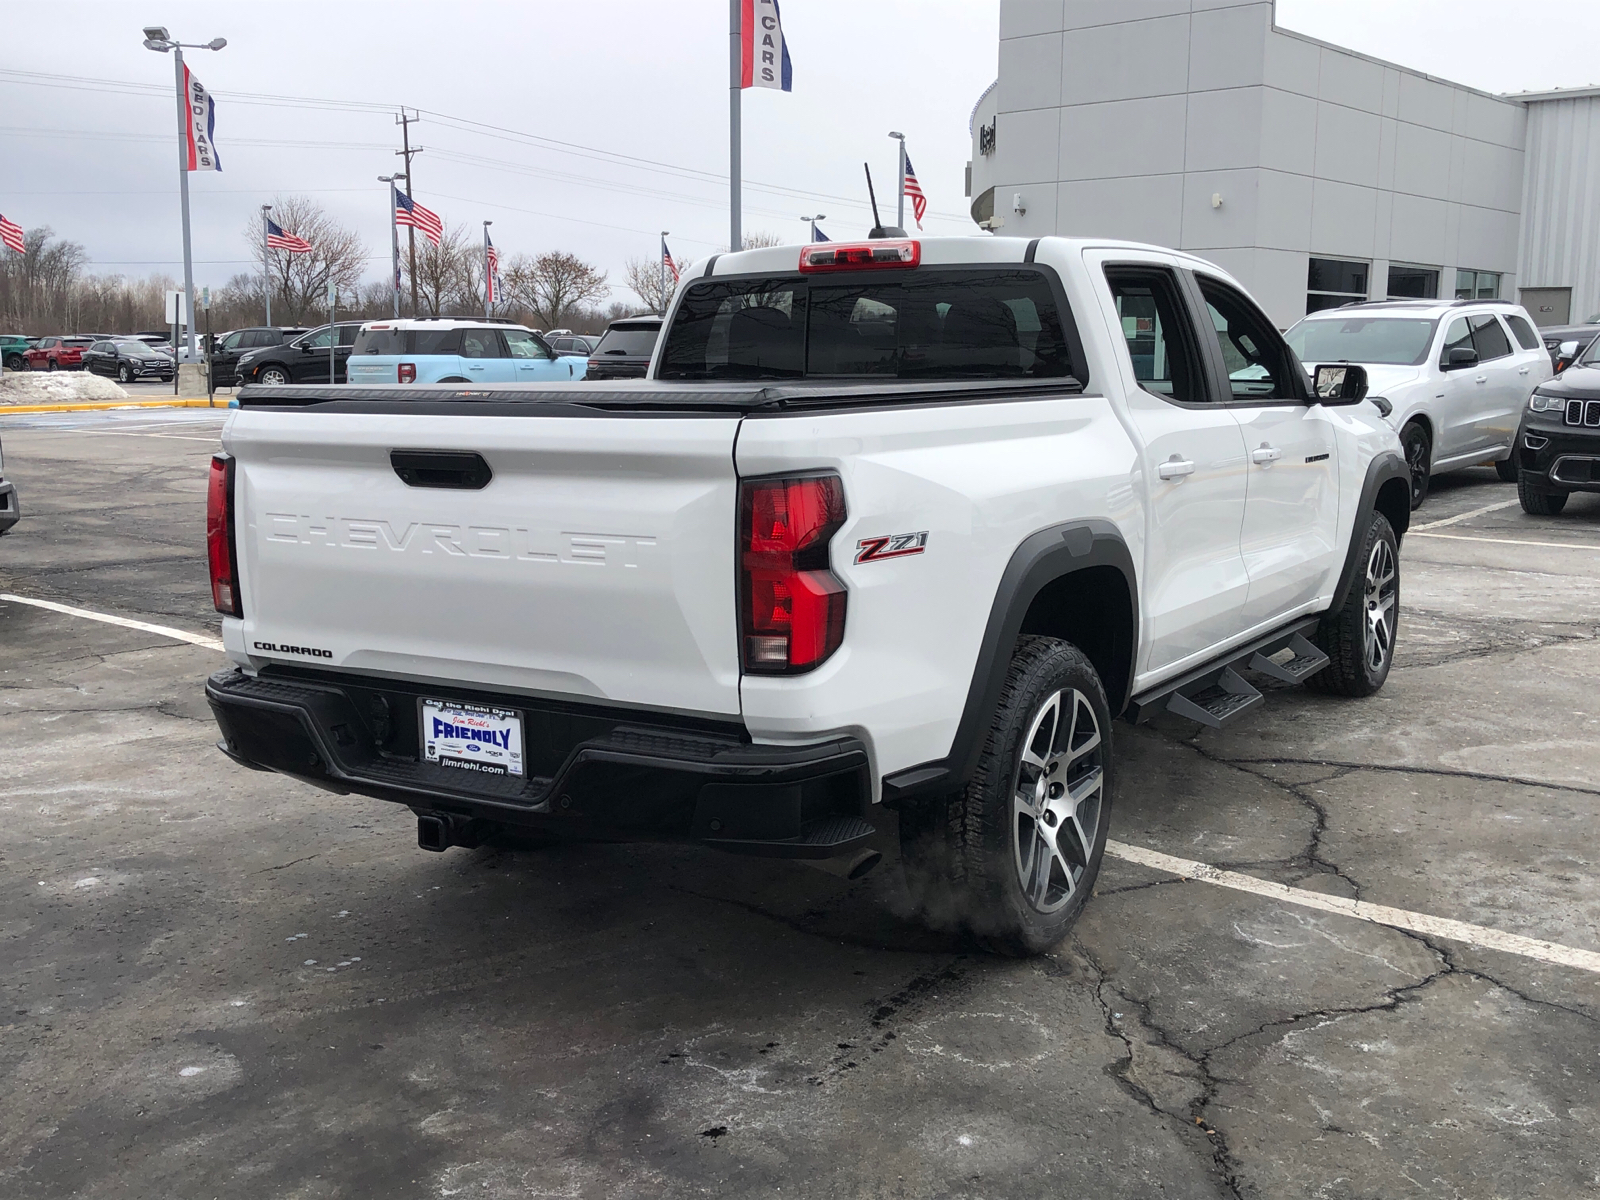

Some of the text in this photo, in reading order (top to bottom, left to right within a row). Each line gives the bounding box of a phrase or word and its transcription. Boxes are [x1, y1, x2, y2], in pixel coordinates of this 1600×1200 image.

[761, 16, 776, 82] CARS
[192, 82, 211, 166] SED CARS
[265, 512, 657, 568] CHEVROLET
[853, 530, 929, 565] Z71
[253, 641, 333, 658] COLORADO
[452, 716, 490, 728] Jim Riehl's
[464, 704, 489, 713] Riehl
[492, 708, 515, 716] Deal
[432, 716, 511, 751] FRIENDLY
[442, 758, 504, 775] jimriehl.com
